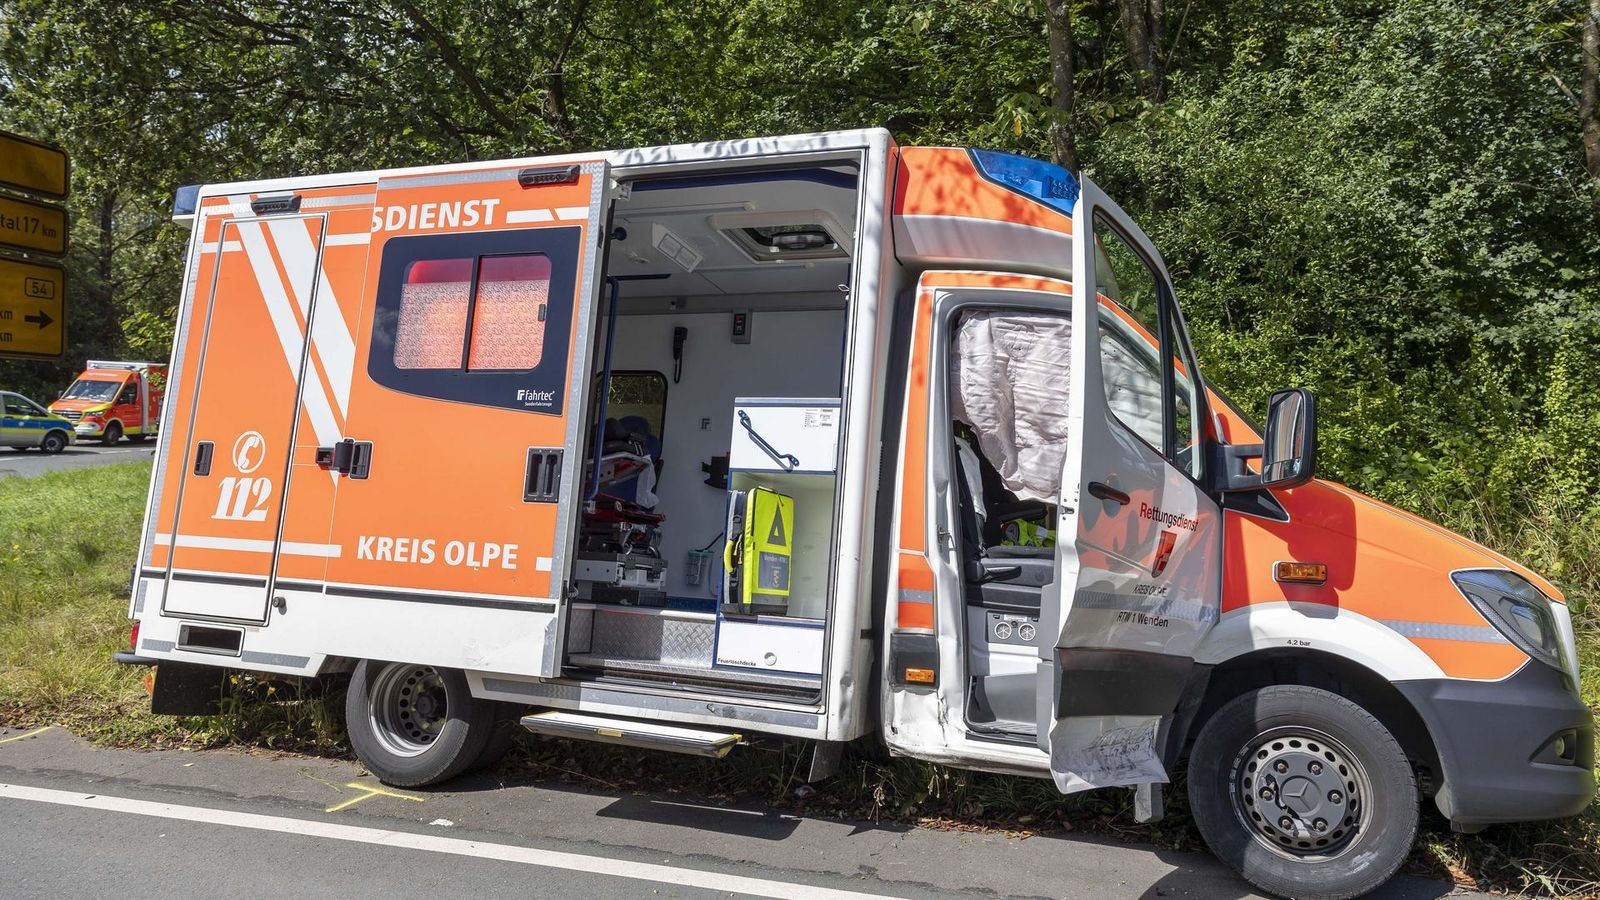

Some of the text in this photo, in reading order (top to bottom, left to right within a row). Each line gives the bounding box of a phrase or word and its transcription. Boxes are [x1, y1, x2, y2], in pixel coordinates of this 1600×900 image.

[23, 216, 40, 234] 17
[42, 224, 56, 238] km
[371, 198, 500, 233] SDIENST
[31, 281, 48, 295] 54
[211, 476, 273, 522] 112
[1140, 502, 1199, 532] Rettungsdienst
[356, 535, 519, 570] KREIS OLPE
[1117, 611, 1132, 623] RTW
[1138, 612, 1169, 628] Wenden
